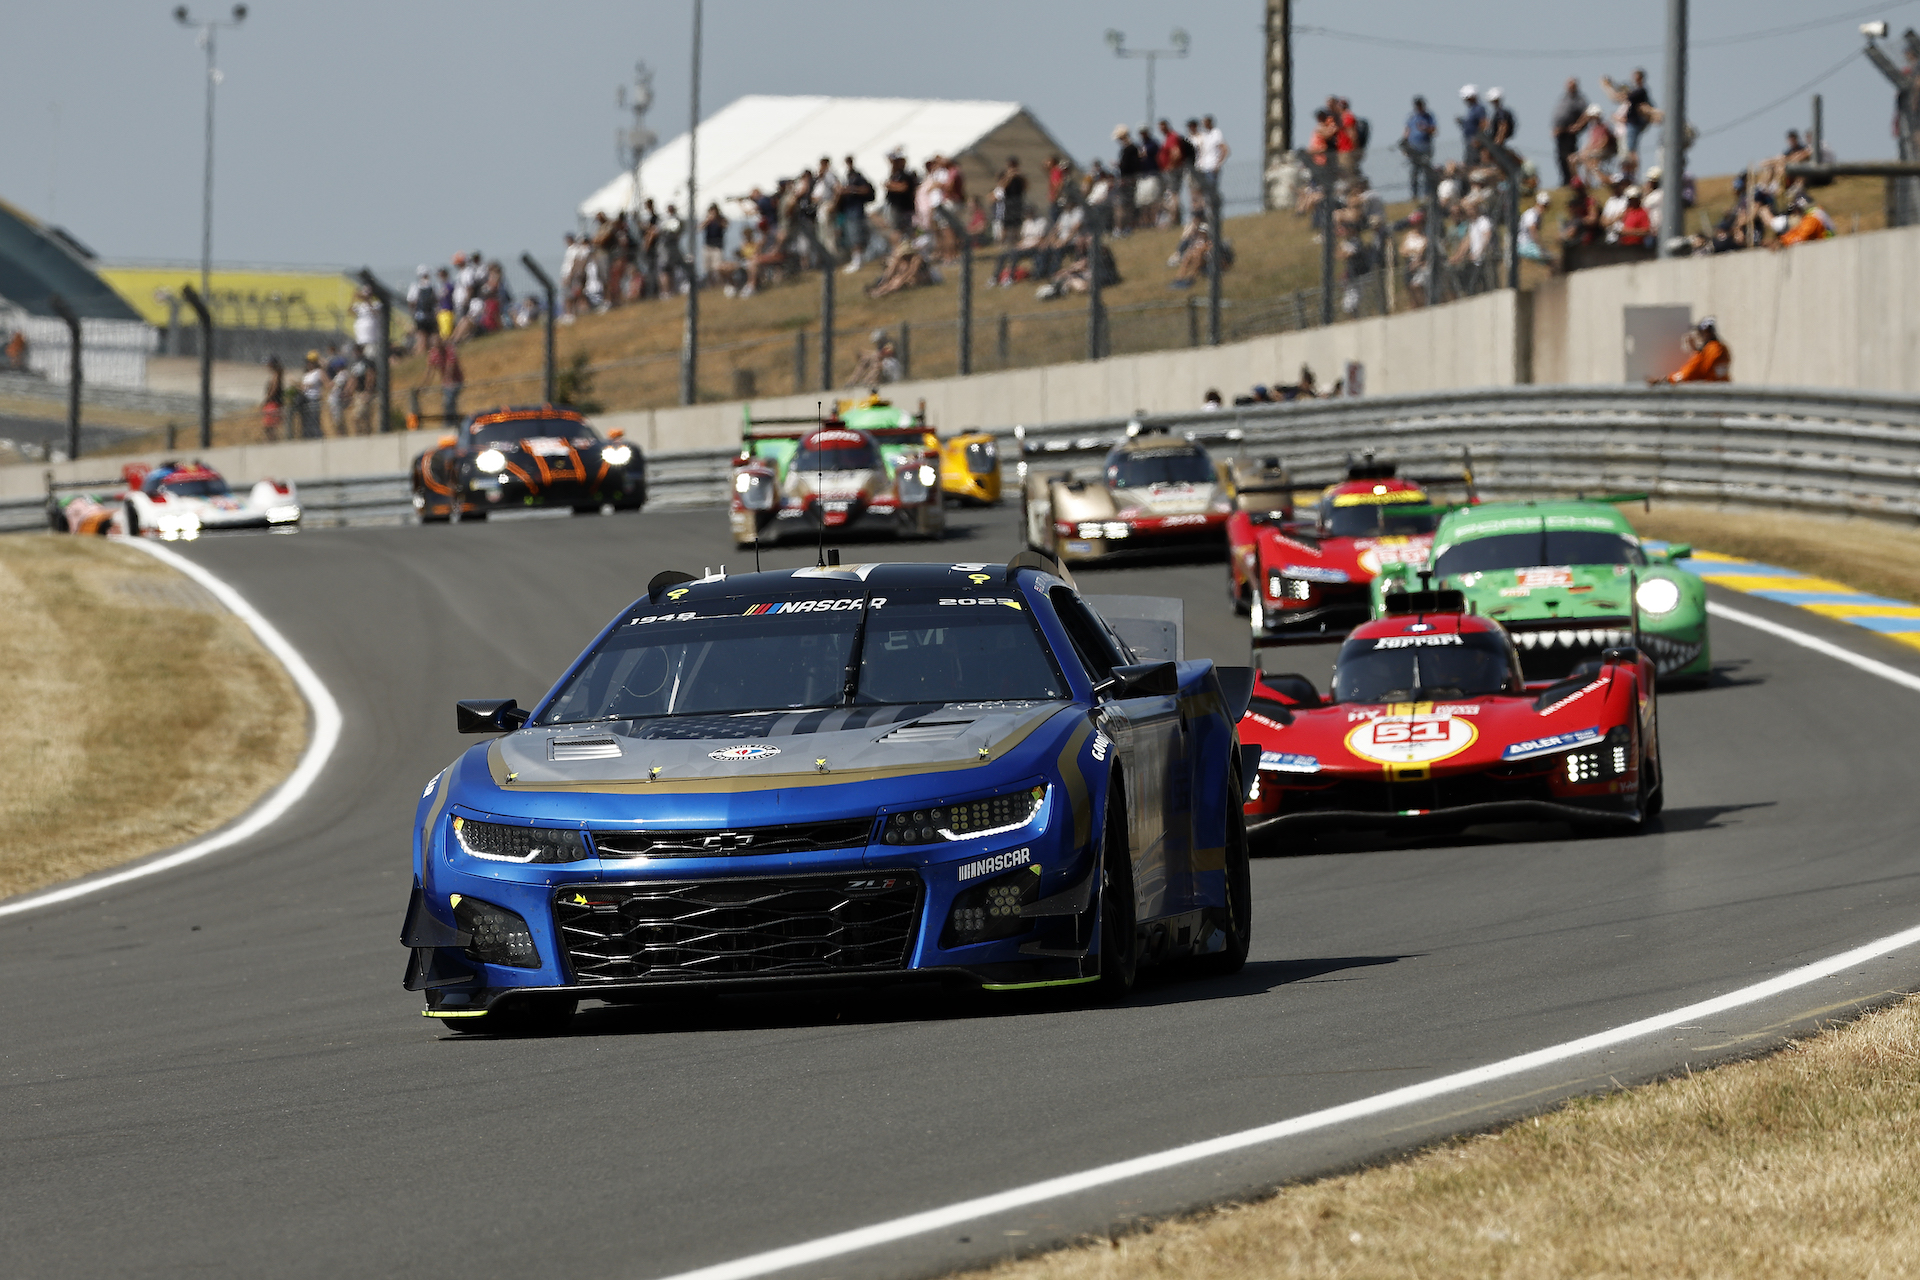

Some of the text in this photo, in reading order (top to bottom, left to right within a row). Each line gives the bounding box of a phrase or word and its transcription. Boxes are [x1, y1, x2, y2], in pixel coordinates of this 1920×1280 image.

[775, 597, 888, 615] NASCAR
[629, 612, 697, 627] 1948
[1373, 632, 1464, 650] Ferrari
[1375, 721, 1449, 742] 51
[1509, 735, 1562, 754] ADLER
[976, 847, 1031, 877] NASCAR
[843, 878, 896, 891] ZL1
